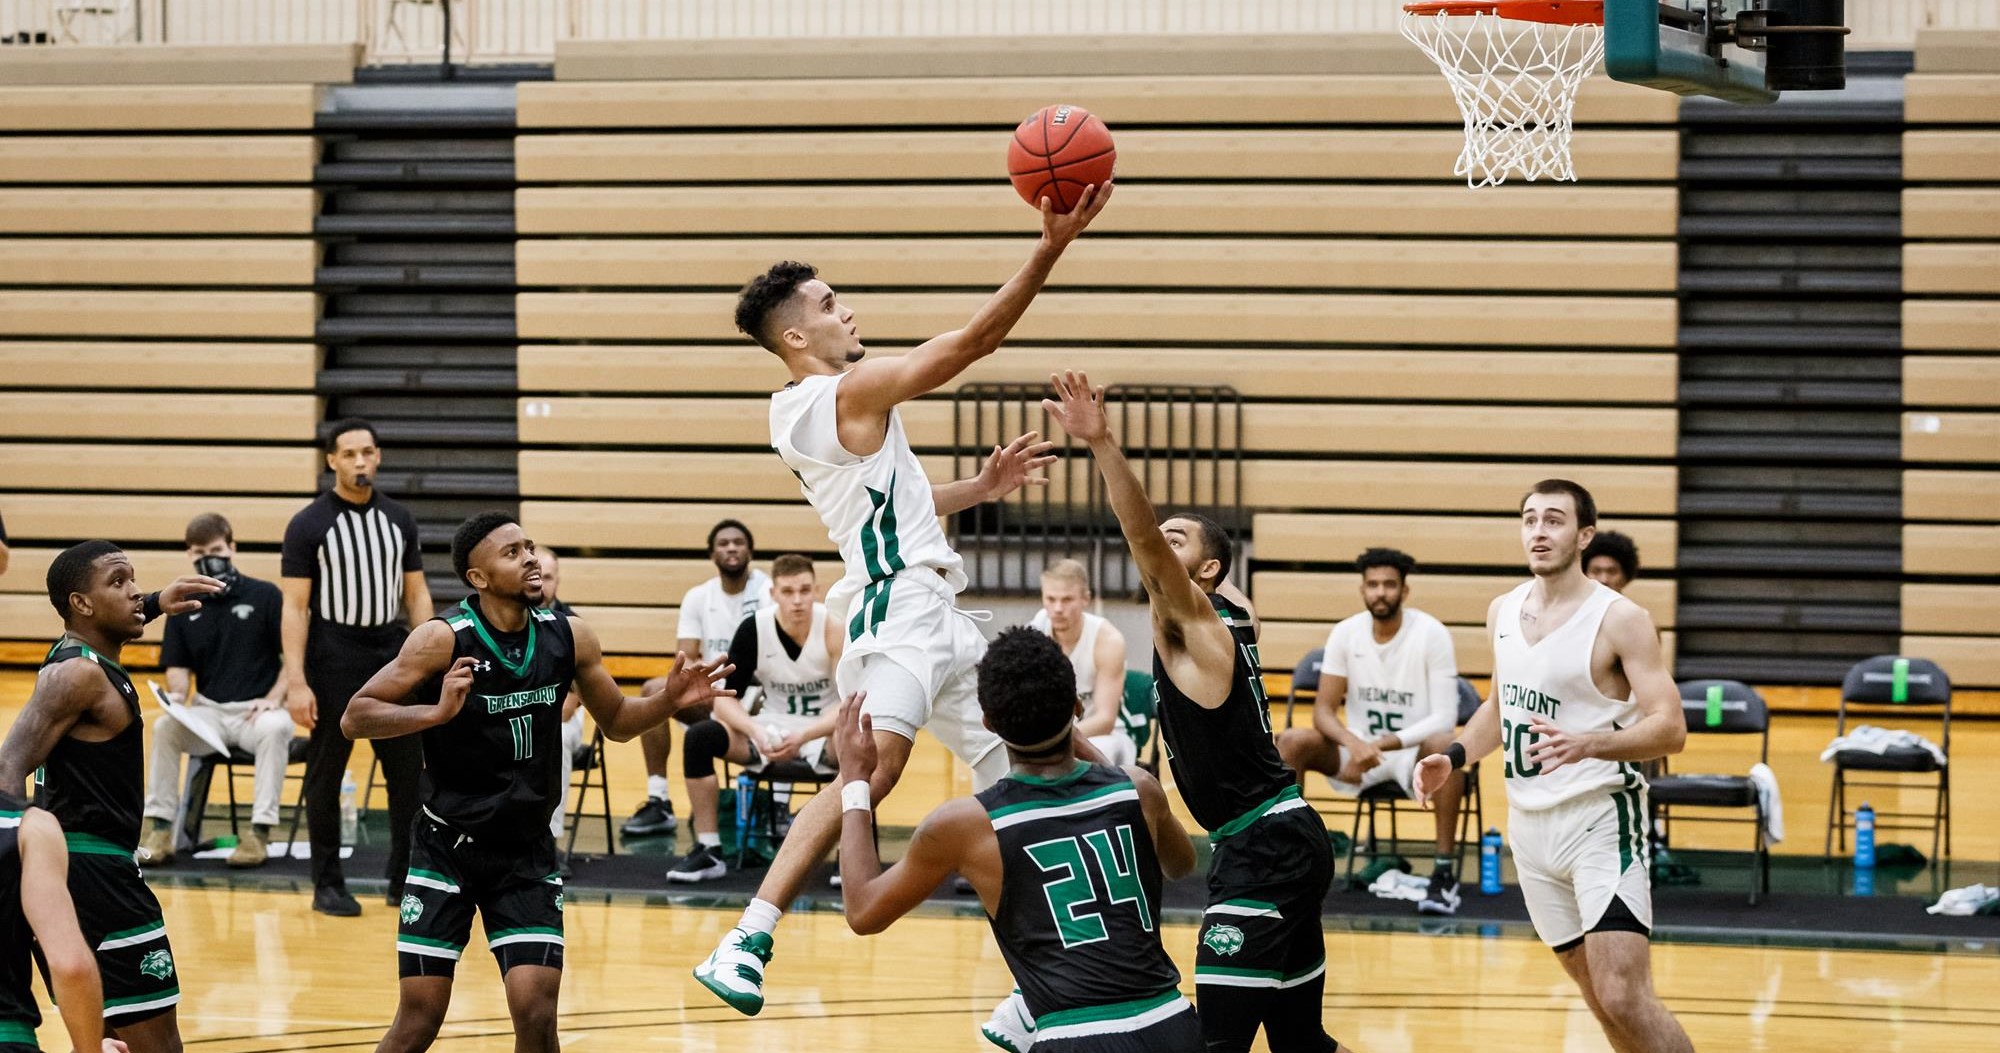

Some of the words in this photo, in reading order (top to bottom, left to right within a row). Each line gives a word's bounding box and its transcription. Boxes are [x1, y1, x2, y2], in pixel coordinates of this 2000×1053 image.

[484, 684, 559, 714] GREENSBORO
[770, 678, 830, 694] PIEDMONT
[1503, 684, 1561, 720] EDMONT
[509, 714, 533, 761] 11
[1023, 824, 1153, 949] 24
